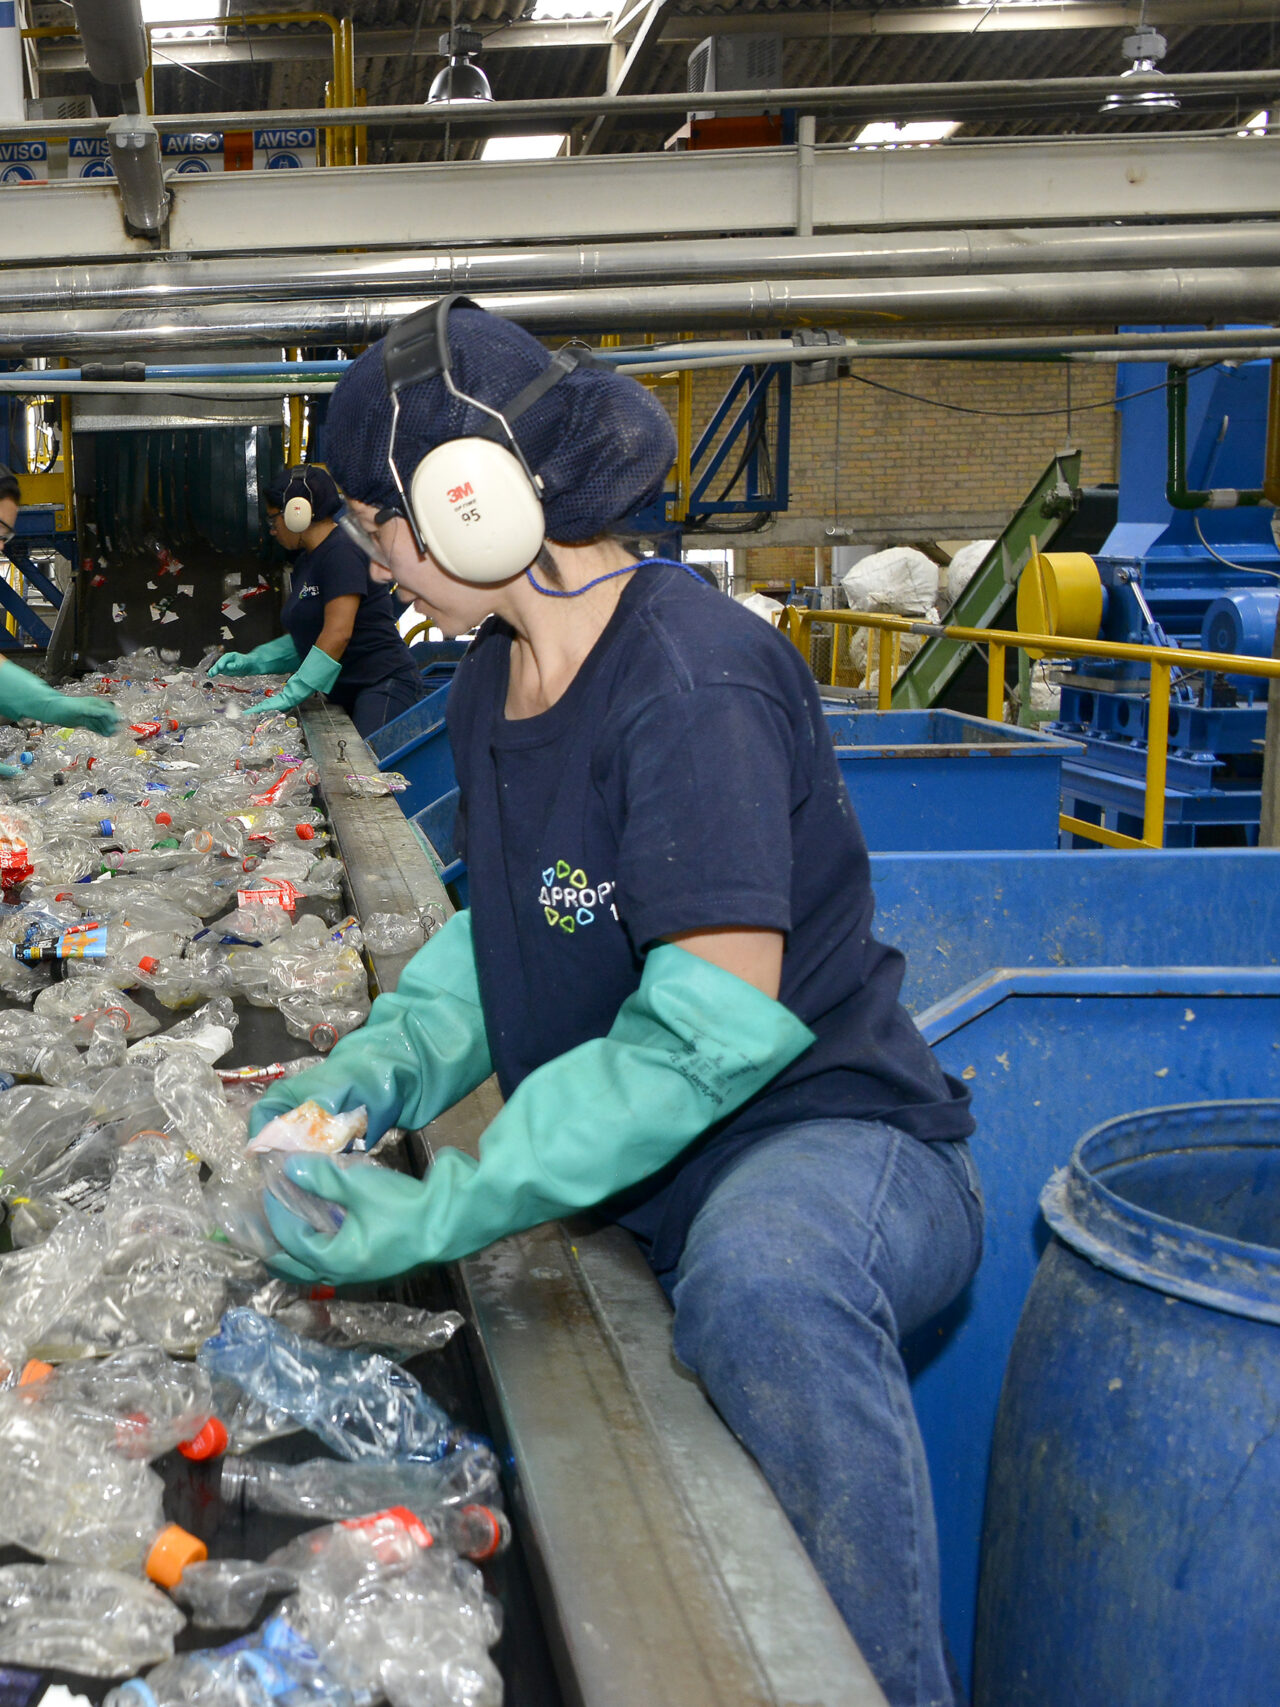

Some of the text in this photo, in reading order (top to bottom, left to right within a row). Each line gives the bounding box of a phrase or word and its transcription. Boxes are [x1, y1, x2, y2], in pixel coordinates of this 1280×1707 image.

[73, 138, 111, 158] AVIS
[166, 133, 220, 153] AVISO
[258, 130, 314, 148] AVISO
[447, 482, 474, 503] 3M
[538, 881, 616, 908] APROP
